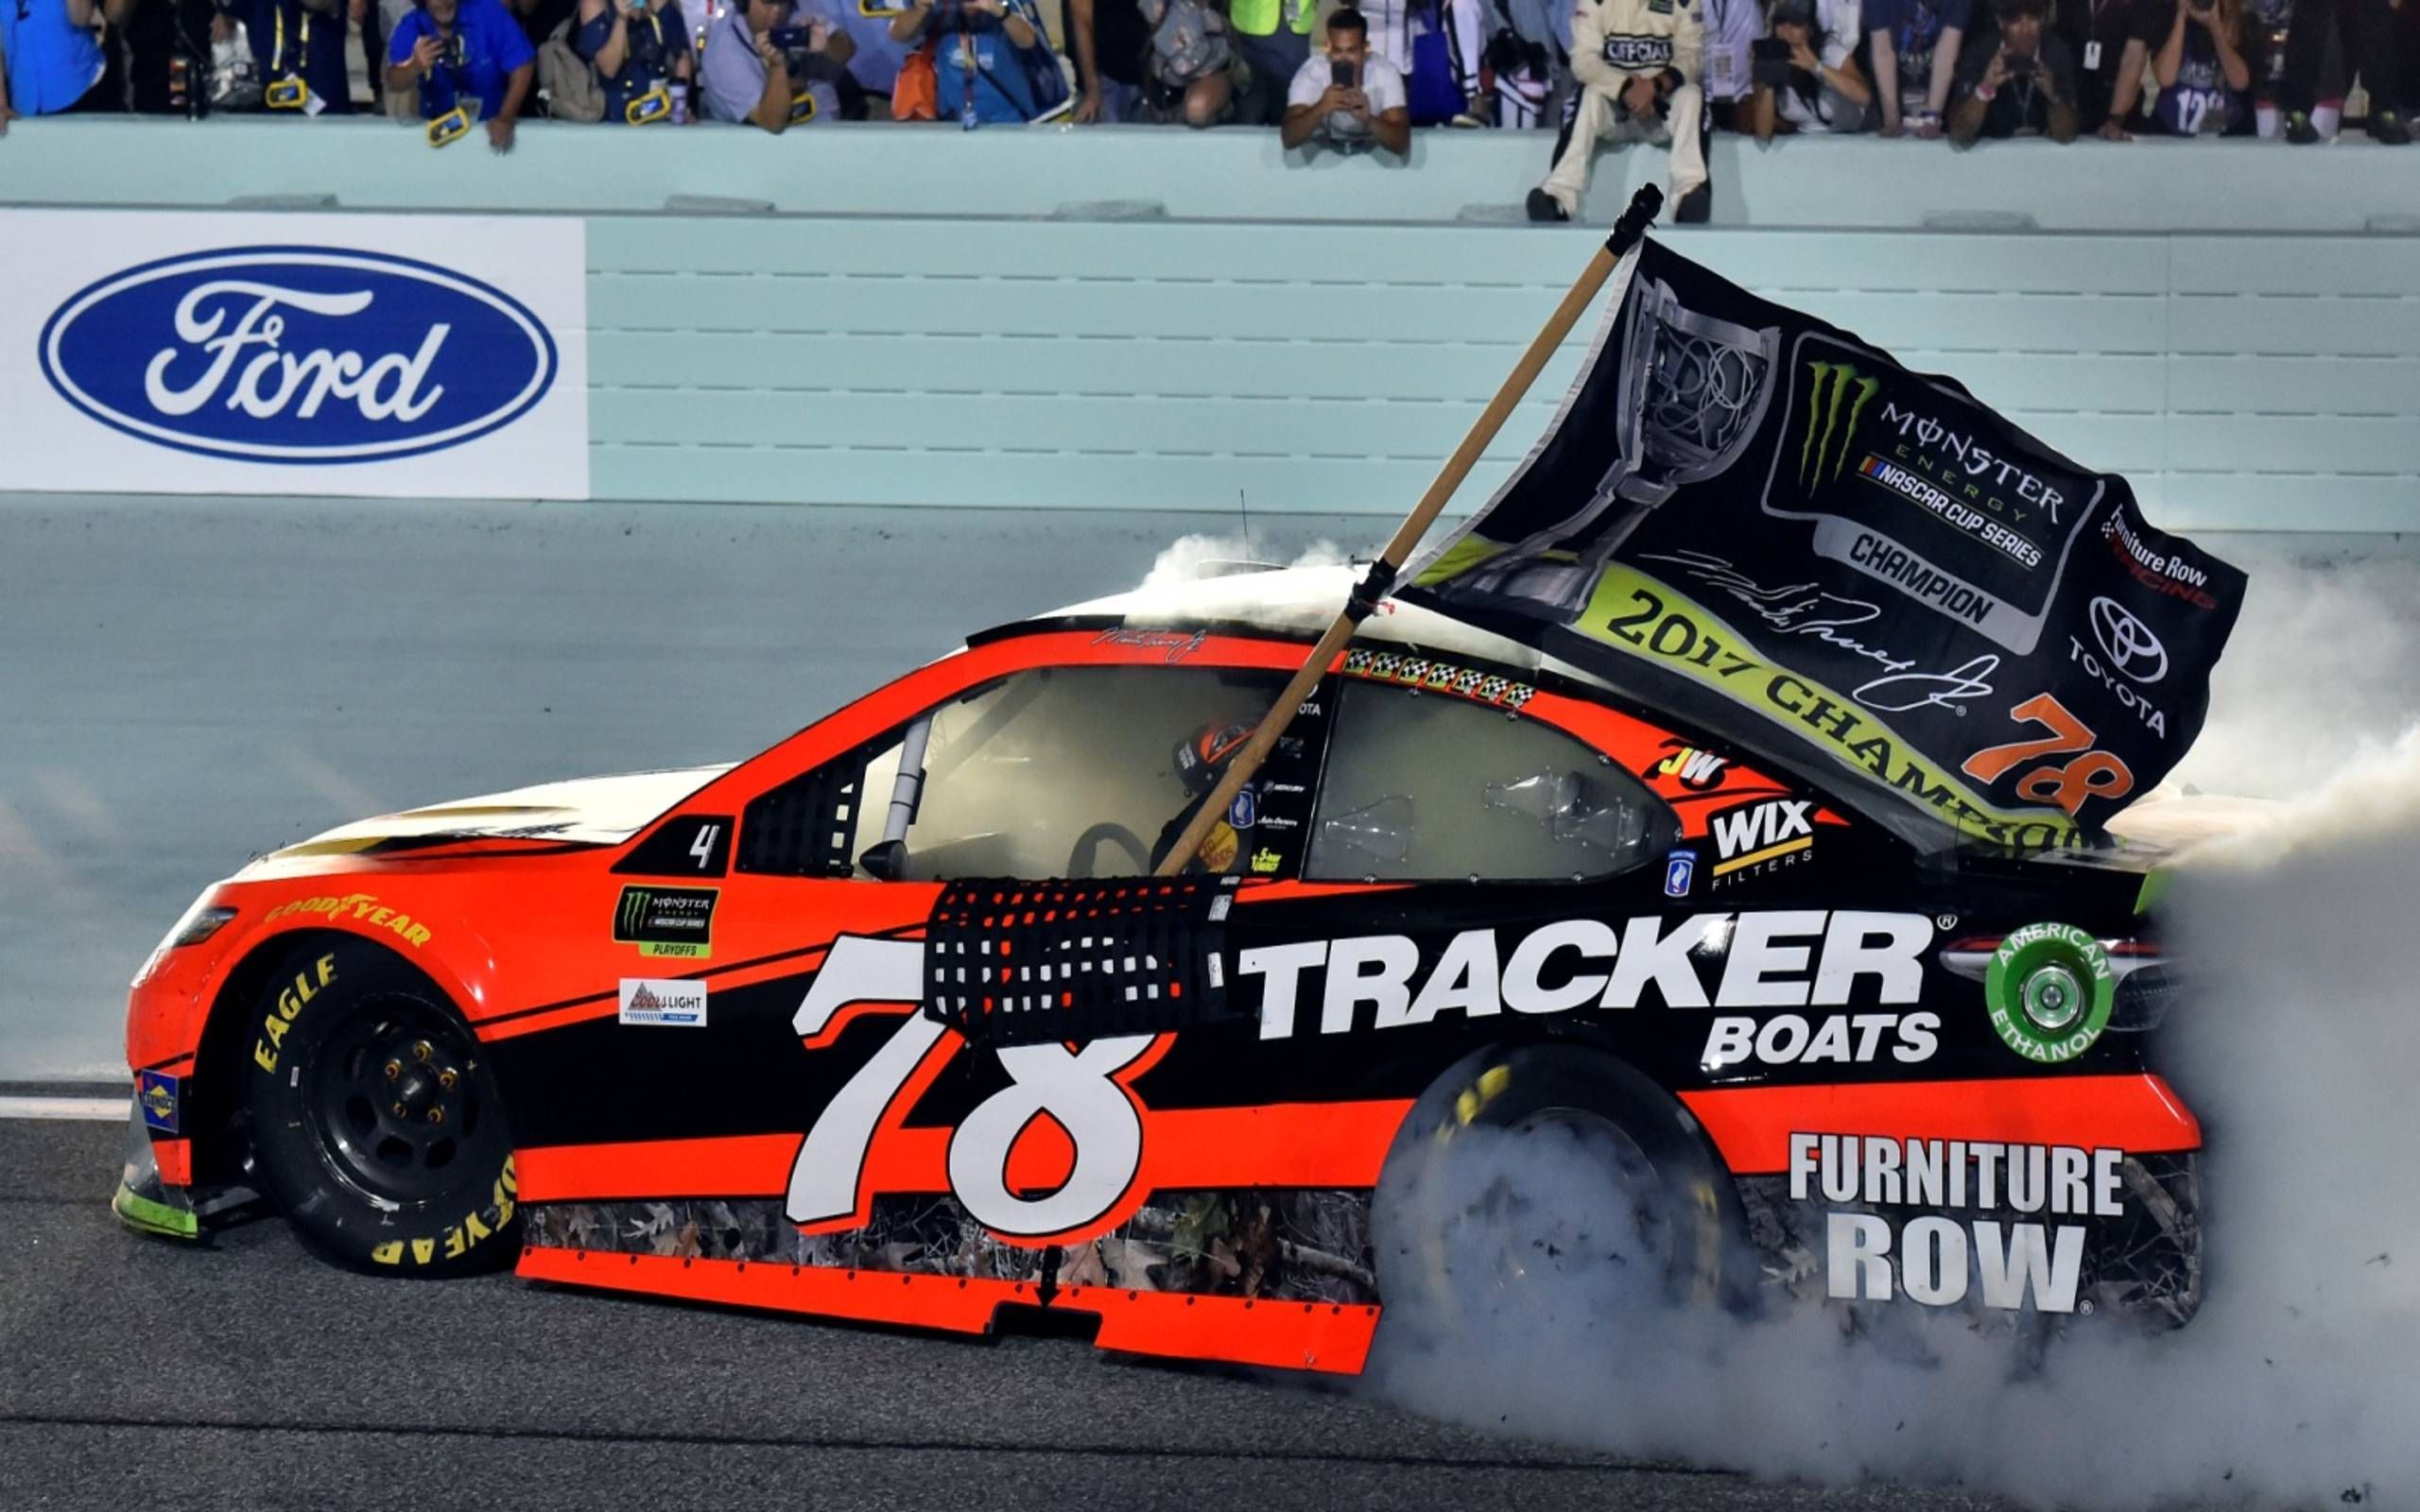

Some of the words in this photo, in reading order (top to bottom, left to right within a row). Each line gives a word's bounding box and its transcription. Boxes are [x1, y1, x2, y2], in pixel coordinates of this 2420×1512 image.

[1607, 42, 1671, 61] OFFCIAL
[145, 281, 450, 422] Ford
[1880, 402, 2065, 524] MONSTER
[1895, 444, 2028, 522] ENERGY
[1878, 460, 1949, 514] NASCAR
[1945, 503, 1986, 530] CUP
[1980, 516, 2044, 568] SERIES
[1849, 532, 1995, 625] CHAMPION
[2165, 555, 2208, 588] Row
[1606, 588, 1762, 678] 2017
[2070, 635, 2167, 739] TOYOTA
[1961, 692, 2135, 817] 78
[689, 825, 720, 868] 4
[1713, 800, 1813, 859] WIX
[652, 896, 710, 910] MONSTER
[1712, 850, 1813, 891] FILTERS
[265, 892, 432, 948] GOODYEAR
[652, 943, 697, 956] PLAYOFFS
[1997, 922, 2111, 981] AMERICAN
[254, 953, 337, 1074] EAGLE
[667, 995, 701, 1009] LIGHT
[1238, 911, 1934, 1040] TRACKER
[1702, 1010, 1941, 1067] BOATS
[1991, 1008, 2100, 1061] ETHANOL
[786, 932, 1161, 1238] 78
[1789, 1133, 2124, 1217] FURNITURE
[1827, 1212, 2086, 1313] ROW
